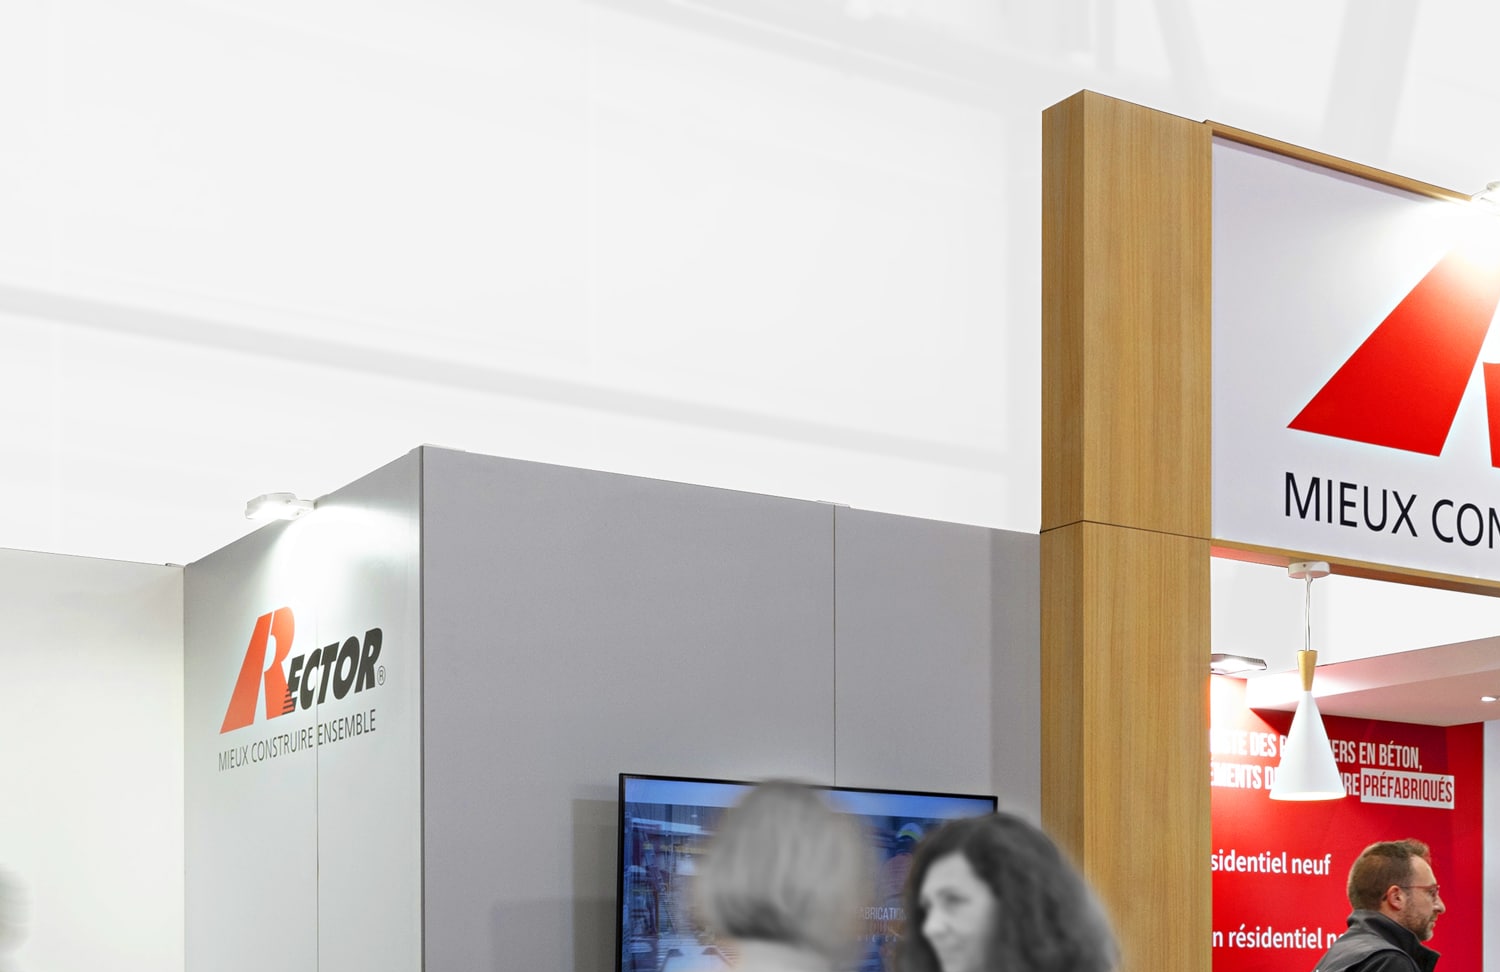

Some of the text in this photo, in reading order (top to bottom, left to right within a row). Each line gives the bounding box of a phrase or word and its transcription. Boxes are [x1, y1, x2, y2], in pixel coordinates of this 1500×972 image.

[1285, 471, 1418, 538] MIEUX
[218, 708, 376, 772] MIEUX CONSTRUIRE ENSEMBLE
[1249, 731, 1277, 757] DES
[1359, 741, 1376, 765] EN
[1379, 740, 1423, 772] BÉTON,
[1363, 771, 1453, 803] PRÉFABRIQUÉS
[1211, 849, 1332, 875] sidentiel neuf
[1228, 923, 1323, 949] résidentiel
